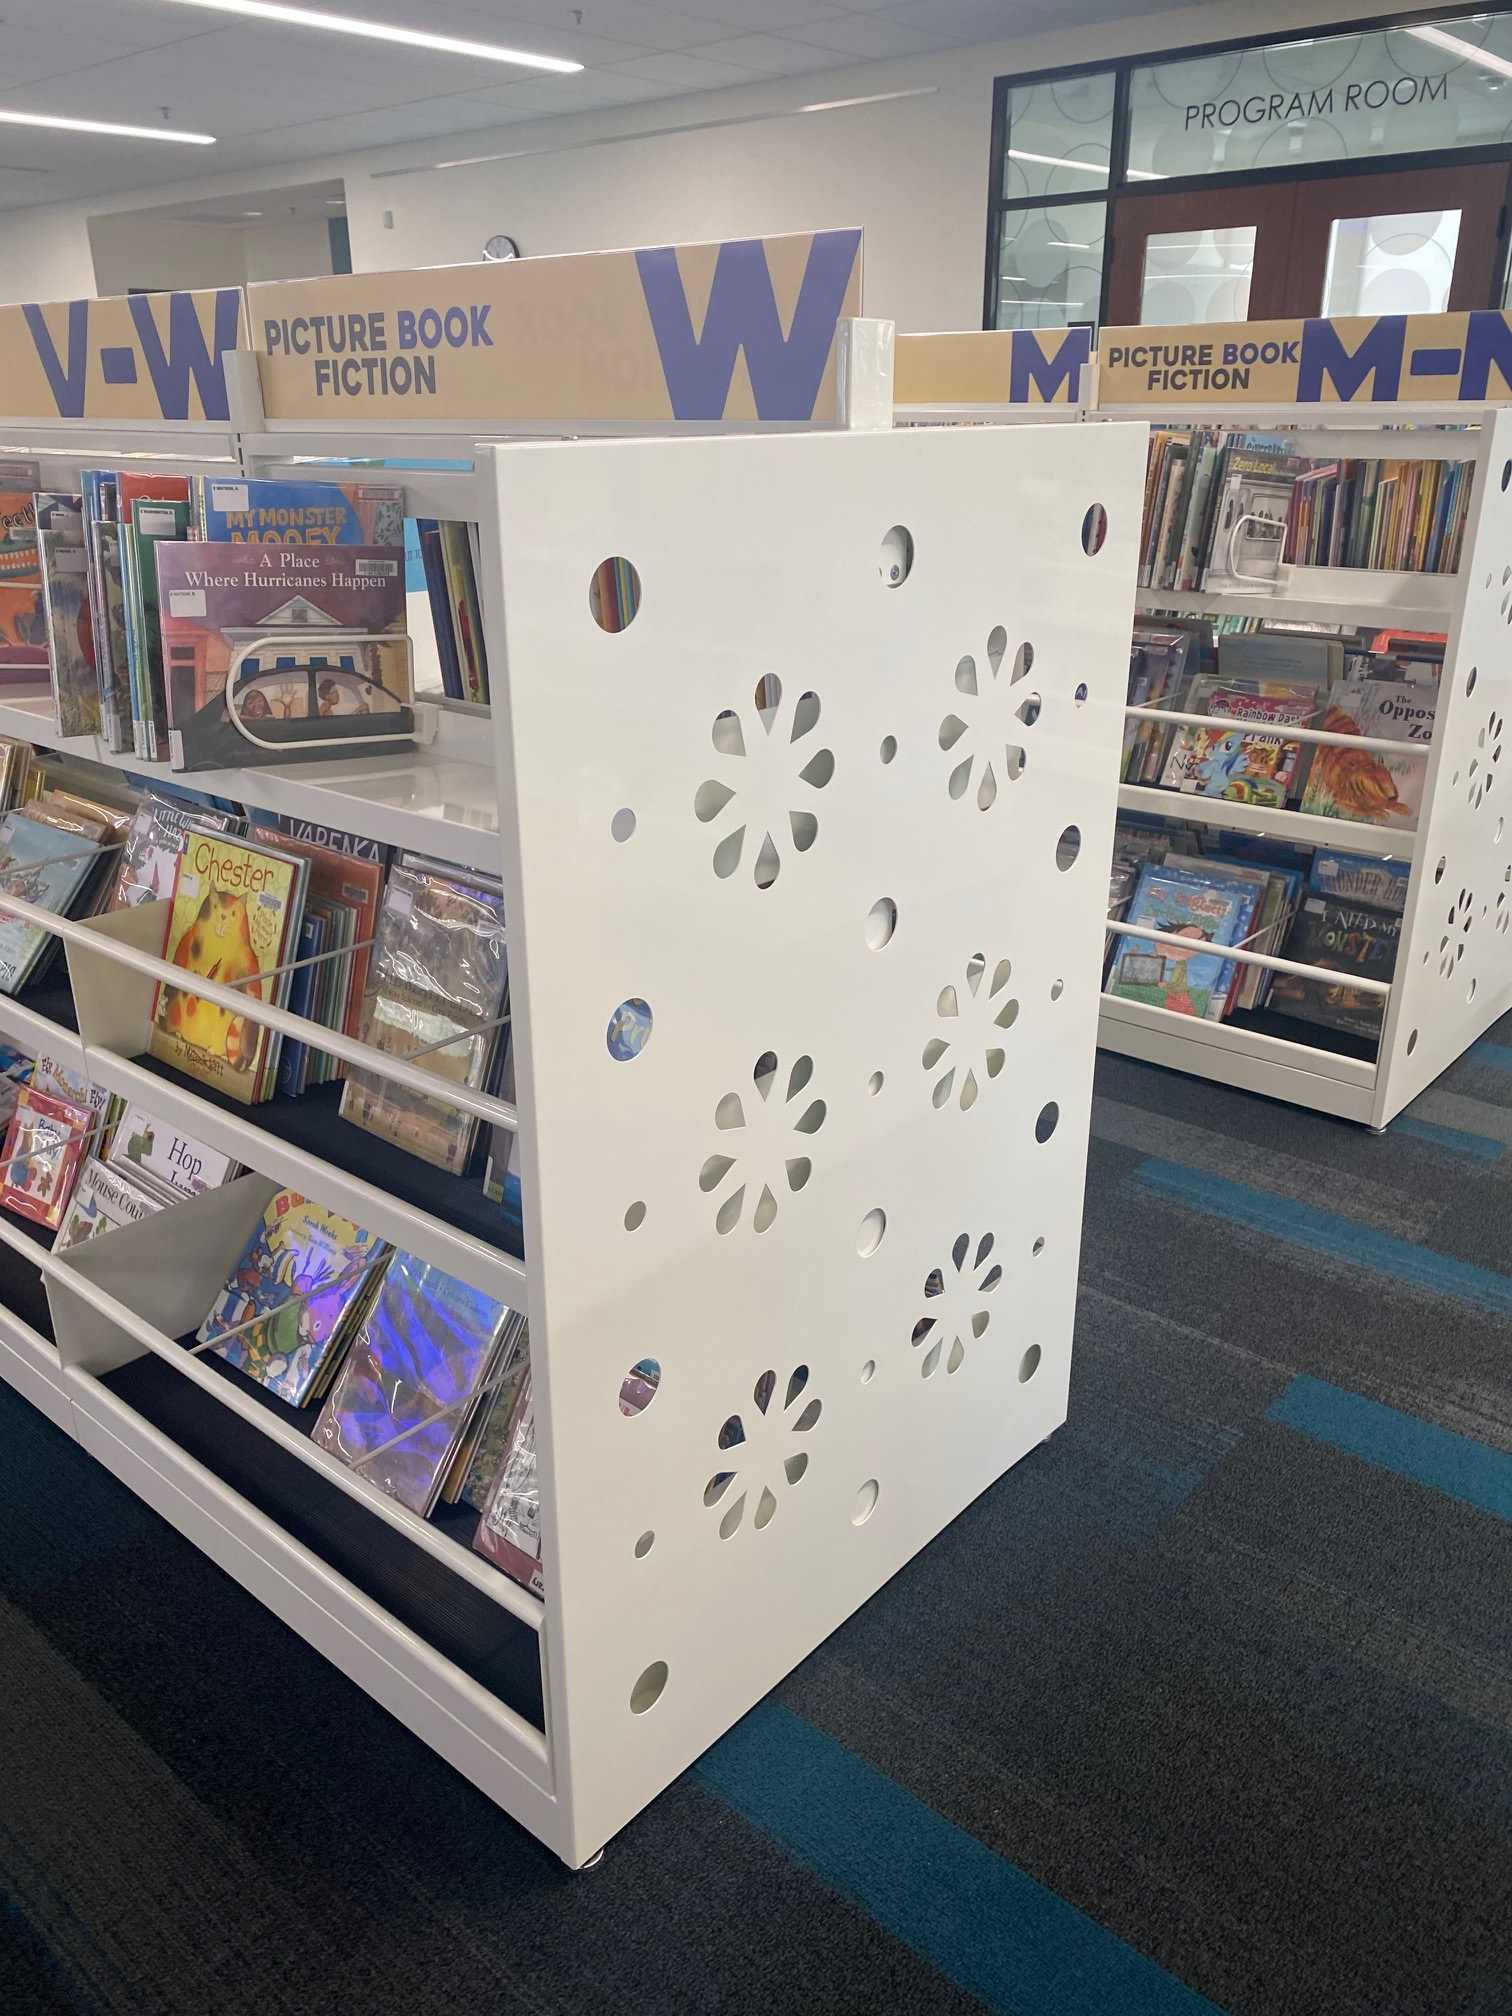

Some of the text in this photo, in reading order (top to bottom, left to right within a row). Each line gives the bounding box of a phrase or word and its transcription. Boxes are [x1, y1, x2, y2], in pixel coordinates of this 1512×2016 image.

[1184, 73, 1448, 131] PROGRAM ROOM
[264, 305, 494, 356] PICTURE BOOK
[634, 229, 862, 421] W
[1009, 327, 1090, 403] M
[1109, 341, 1300, 368] PICTURE BOOK
[314, 356, 436, 396] FICTION
[1147, 368, 1250, 391] FICTION
[259, 507, 346, 527] MONSTER
[259, 552, 320, 568] A Place
[185, 571, 387, 590] Where Hurricanes Happen
[1237, 707, 1276, 720] Rainbow
[1379, 699, 1436, 721] Oppos
[1408, 724, 1432, 740] Zo
[195, 843, 274, 892] Chester
[168, 1137, 202, 1181] Hop
[85, 1168, 118, 1204] Mouse
